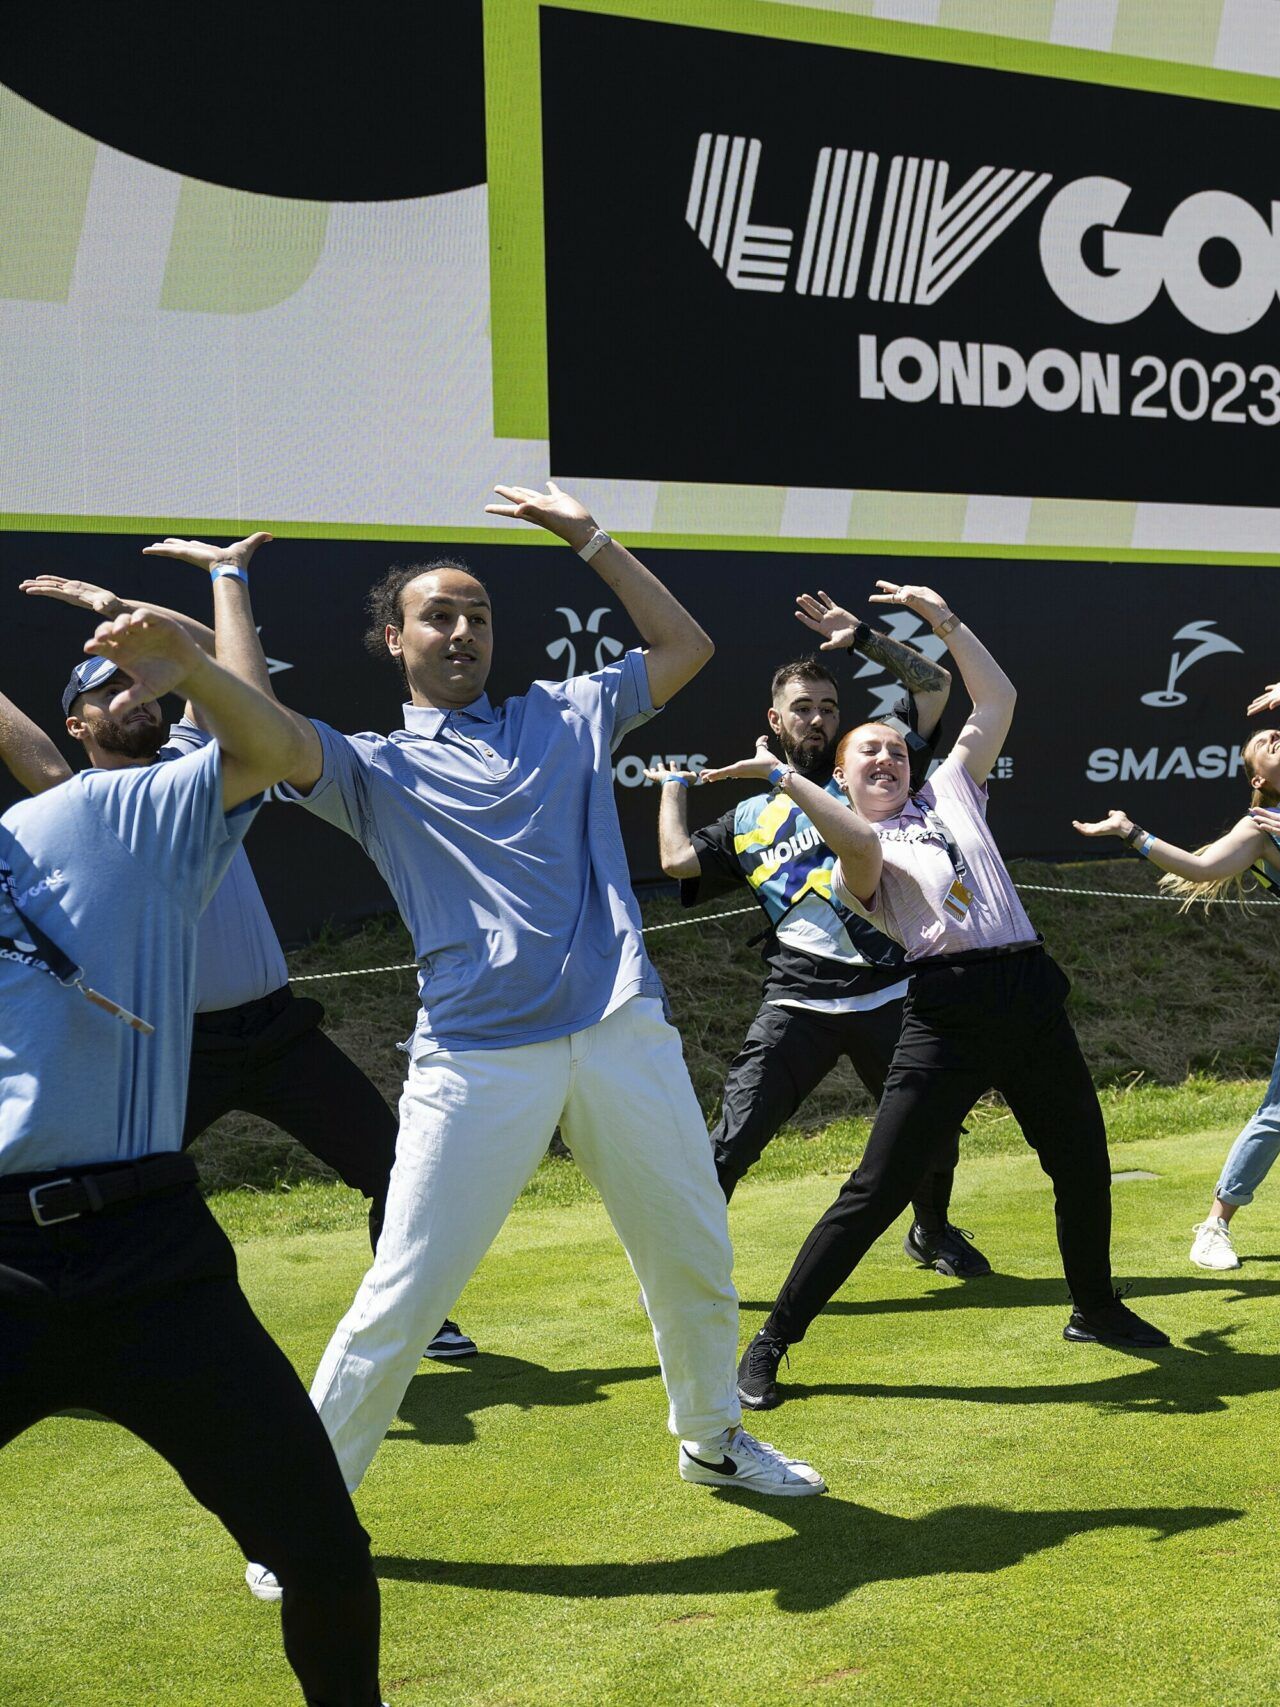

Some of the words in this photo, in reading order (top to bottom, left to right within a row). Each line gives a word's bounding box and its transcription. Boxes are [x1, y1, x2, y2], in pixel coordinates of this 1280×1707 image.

[685, 132, 1053, 306] LIV
[859, 334, 1120, 415] LONDON
[611, 753, 709, 788] OATS
